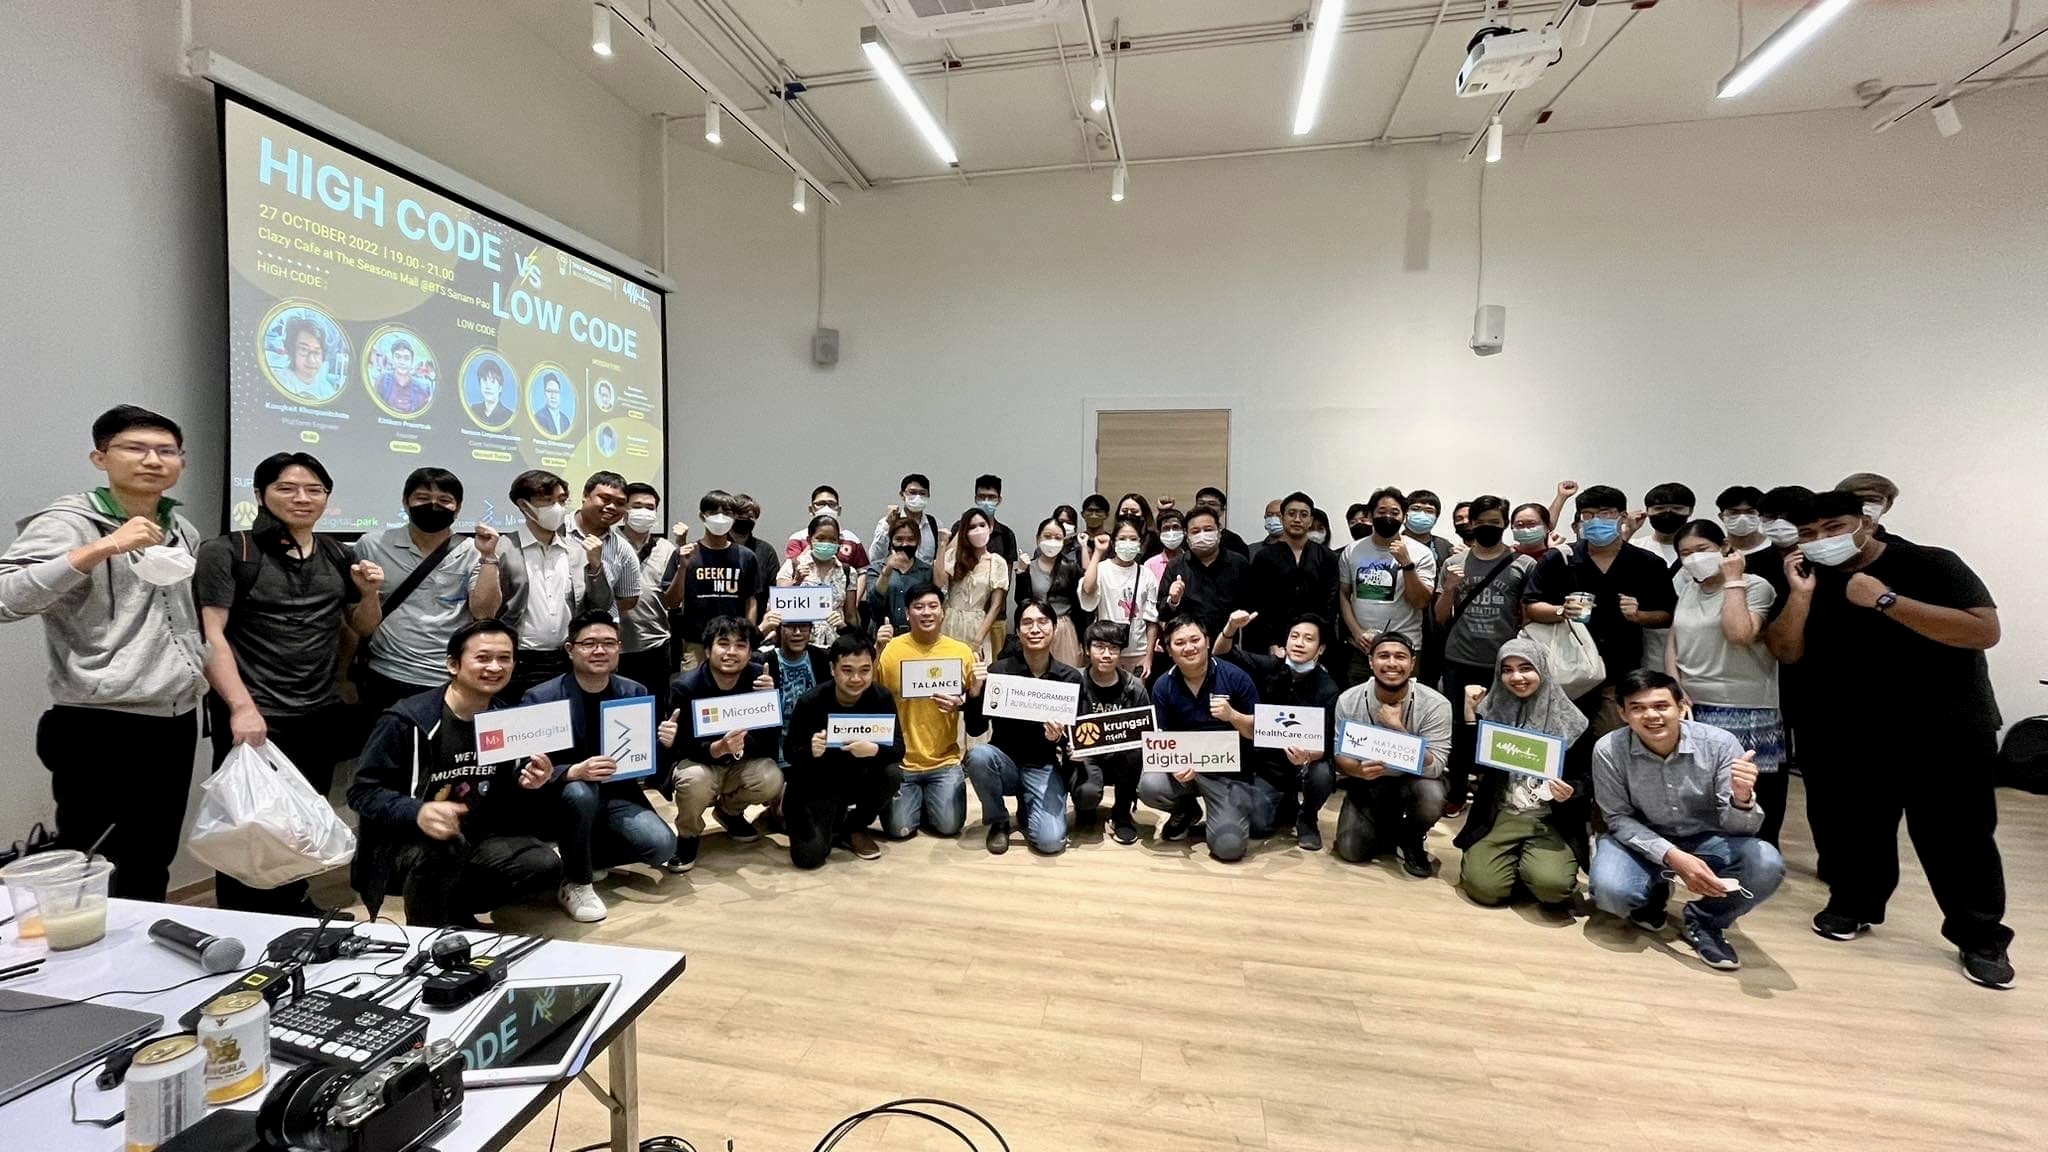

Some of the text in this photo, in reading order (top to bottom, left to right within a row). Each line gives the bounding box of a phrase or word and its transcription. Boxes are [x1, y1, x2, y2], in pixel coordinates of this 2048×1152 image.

[259, 136, 504, 272] HIGH CODE
[259, 204, 278, 221] 27
[282, 211, 347, 245] OCTOBER
[349, 235, 379, 256] 2022
[390, 250, 420, 269] 19.00
[427, 263, 455, 281] 21.00
[257, 227, 490, 310] Clazy Cafe at The Seasons Mall @BTS Sanam Pao
[257, 260, 288, 279] HIGH
[290, 269, 322, 289] CODE
[514, 252, 541, 289] VS
[456, 318, 497, 337] LOW CODE
[493, 281, 563, 335] LOW
[569, 310, 637, 360] CODE
[696, 567, 725, 580] GEEK
[713, 580, 725, 593] IN
[775, 596, 811, 609] brikl
[912, 680, 959, 689] TALANCE
[1010, 689, 1076, 703] THAI PROGRAMMER
[722, 702, 775, 719] Microsoft
[1103, 715, 1150, 732] krungsri
[506, 723, 569, 743] misodigital
[1255, 728, 1323, 740] HealthCare.com
[1146, 737, 1177, 750] true
[1373, 740, 1417, 754] MATADOR
[630, 752, 648, 764] TBN
[1146, 752, 1235, 768] digital_park
[1370, 746, 1416, 763] INVESTOR
